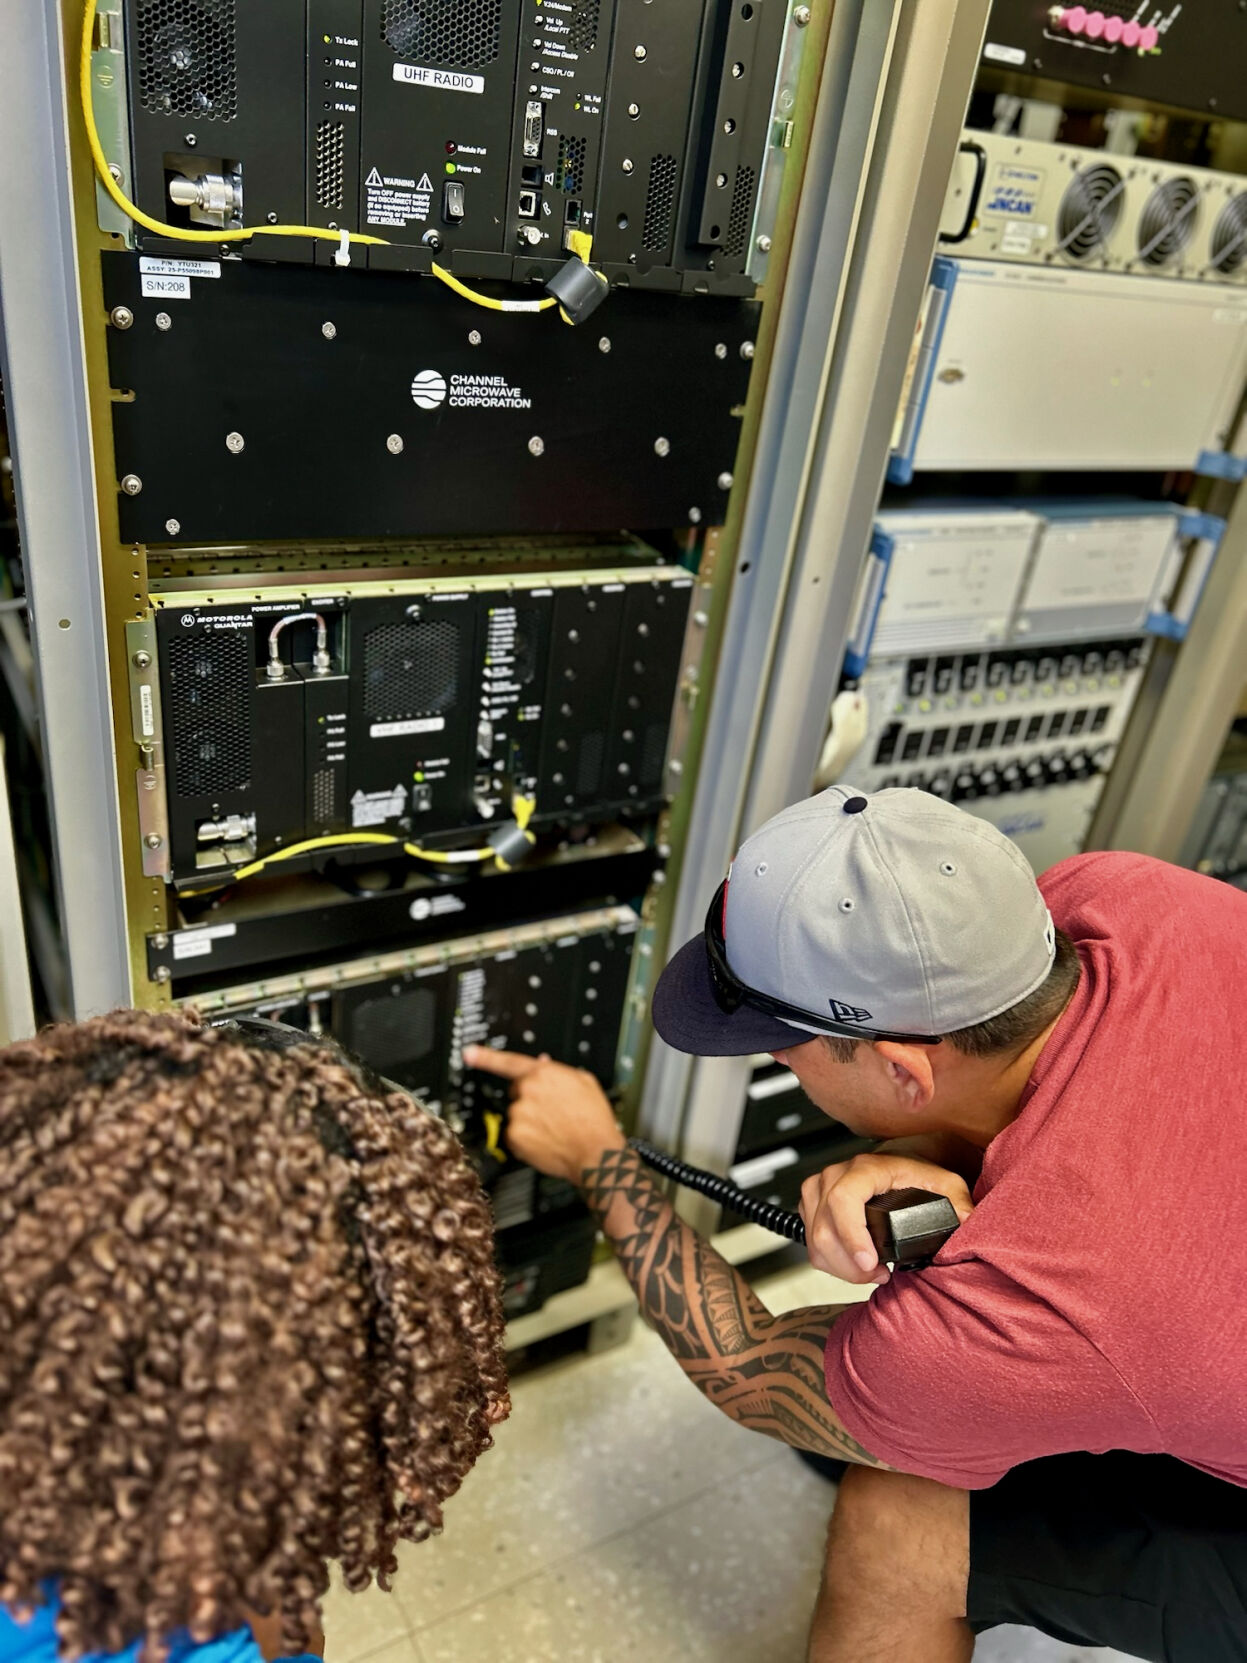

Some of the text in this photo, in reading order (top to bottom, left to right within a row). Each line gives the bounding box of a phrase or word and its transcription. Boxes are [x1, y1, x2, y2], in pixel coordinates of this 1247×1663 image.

[335, 36, 358, 46] Tx Lock
[335, 58, 344, 66] PA
[404, 67, 473, 88] UHF RADIO
[335, 81, 358, 90] PA Low
[335, 103, 344, 111] PA
[457, 164, 481, 174] Power On
[383, 177, 415, 188] WARNING
[367, 187, 380, 195] Turn
[146, 280, 185, 292] S/N:208
[450, 374, 508, 387] CHANNEL
[449, 385, 522, 398] MICROWAVE
[448, 396, 531, 409] CORPORATION
[196, 614, 253, 623] MOTOROLA
